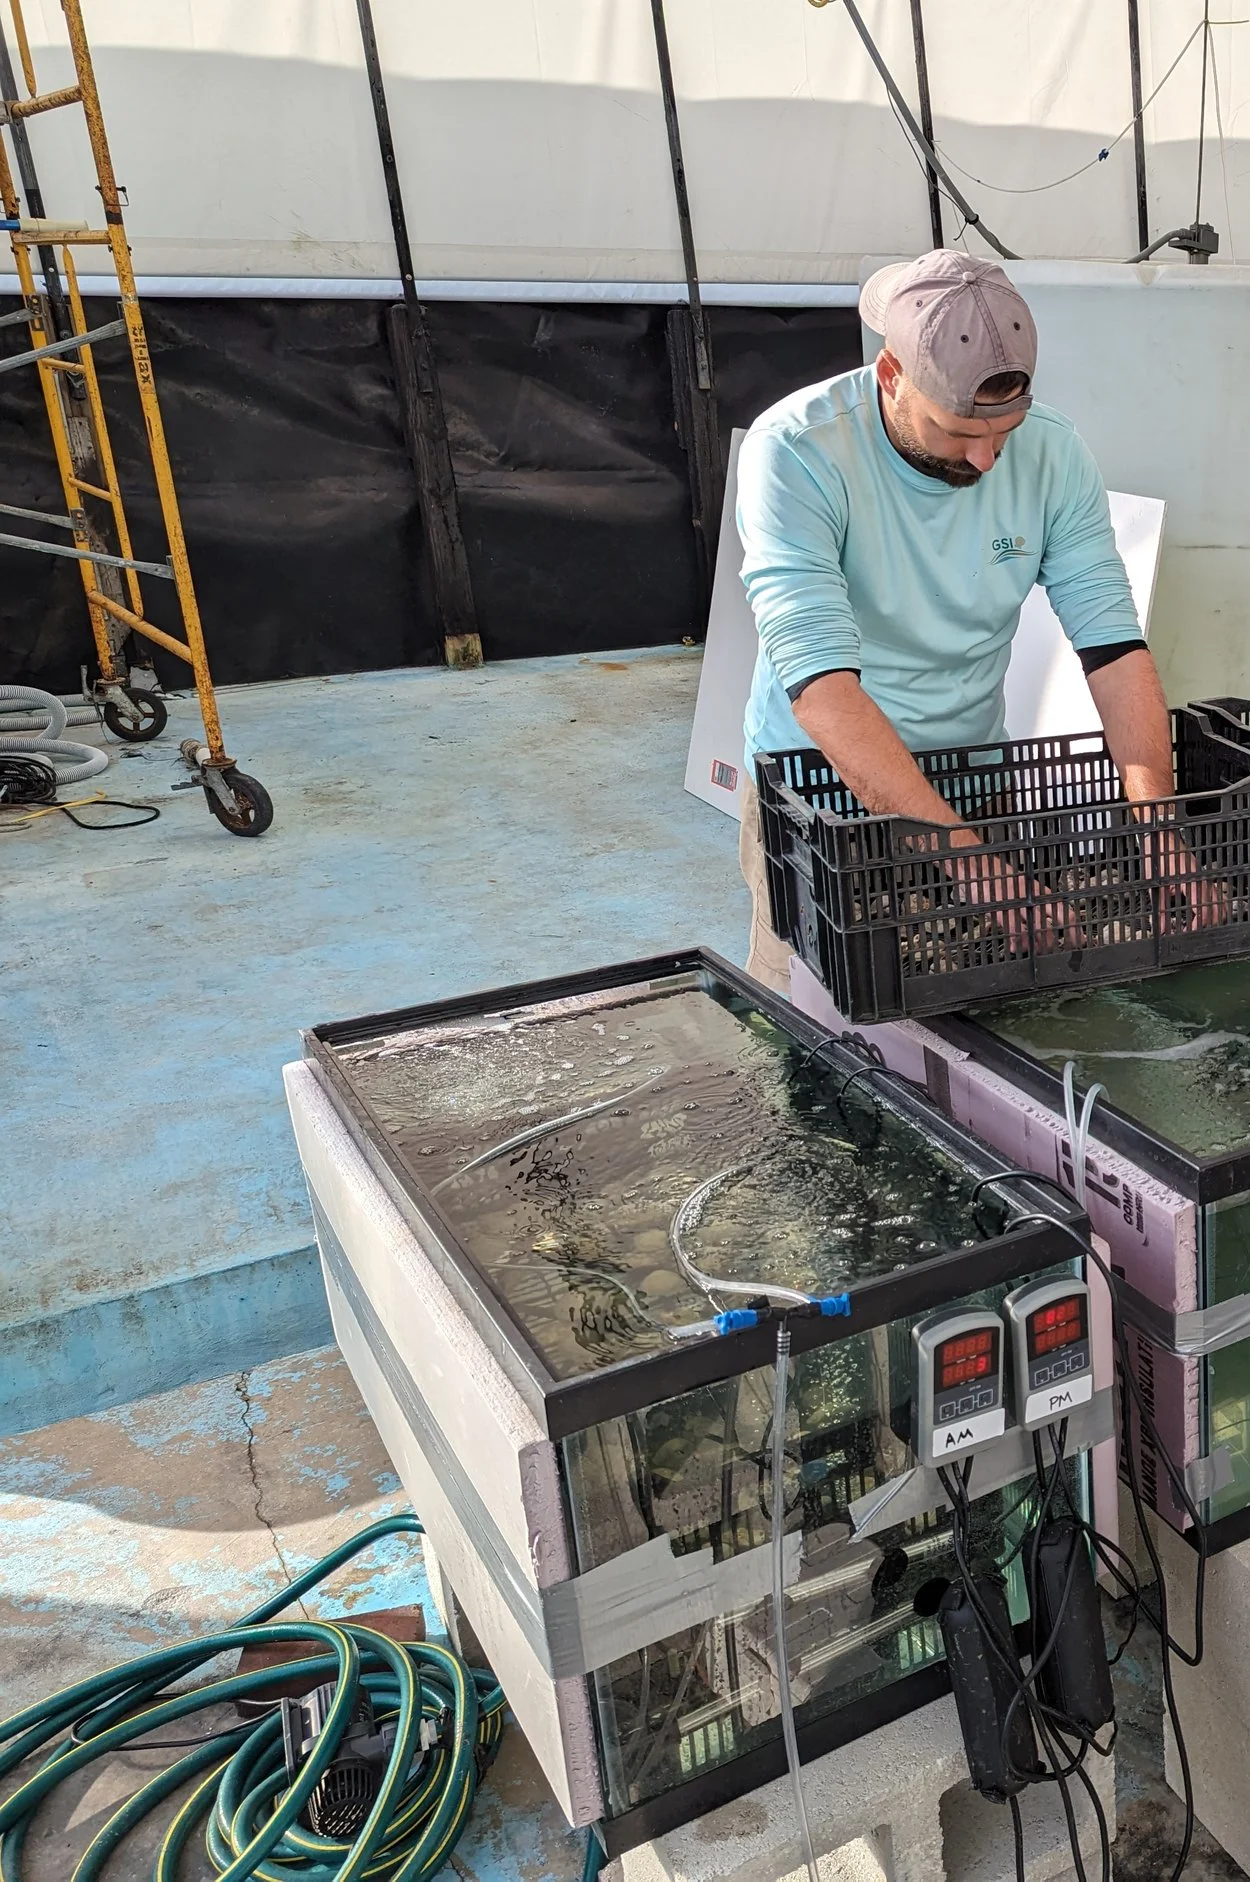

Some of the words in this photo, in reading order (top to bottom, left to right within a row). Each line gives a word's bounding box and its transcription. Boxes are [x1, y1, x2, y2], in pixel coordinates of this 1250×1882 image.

[992, 537, 1014, 551] GSI
[1049, 1390, 1073, 1412] PM
[945, 1428, 974, 1449] AM
